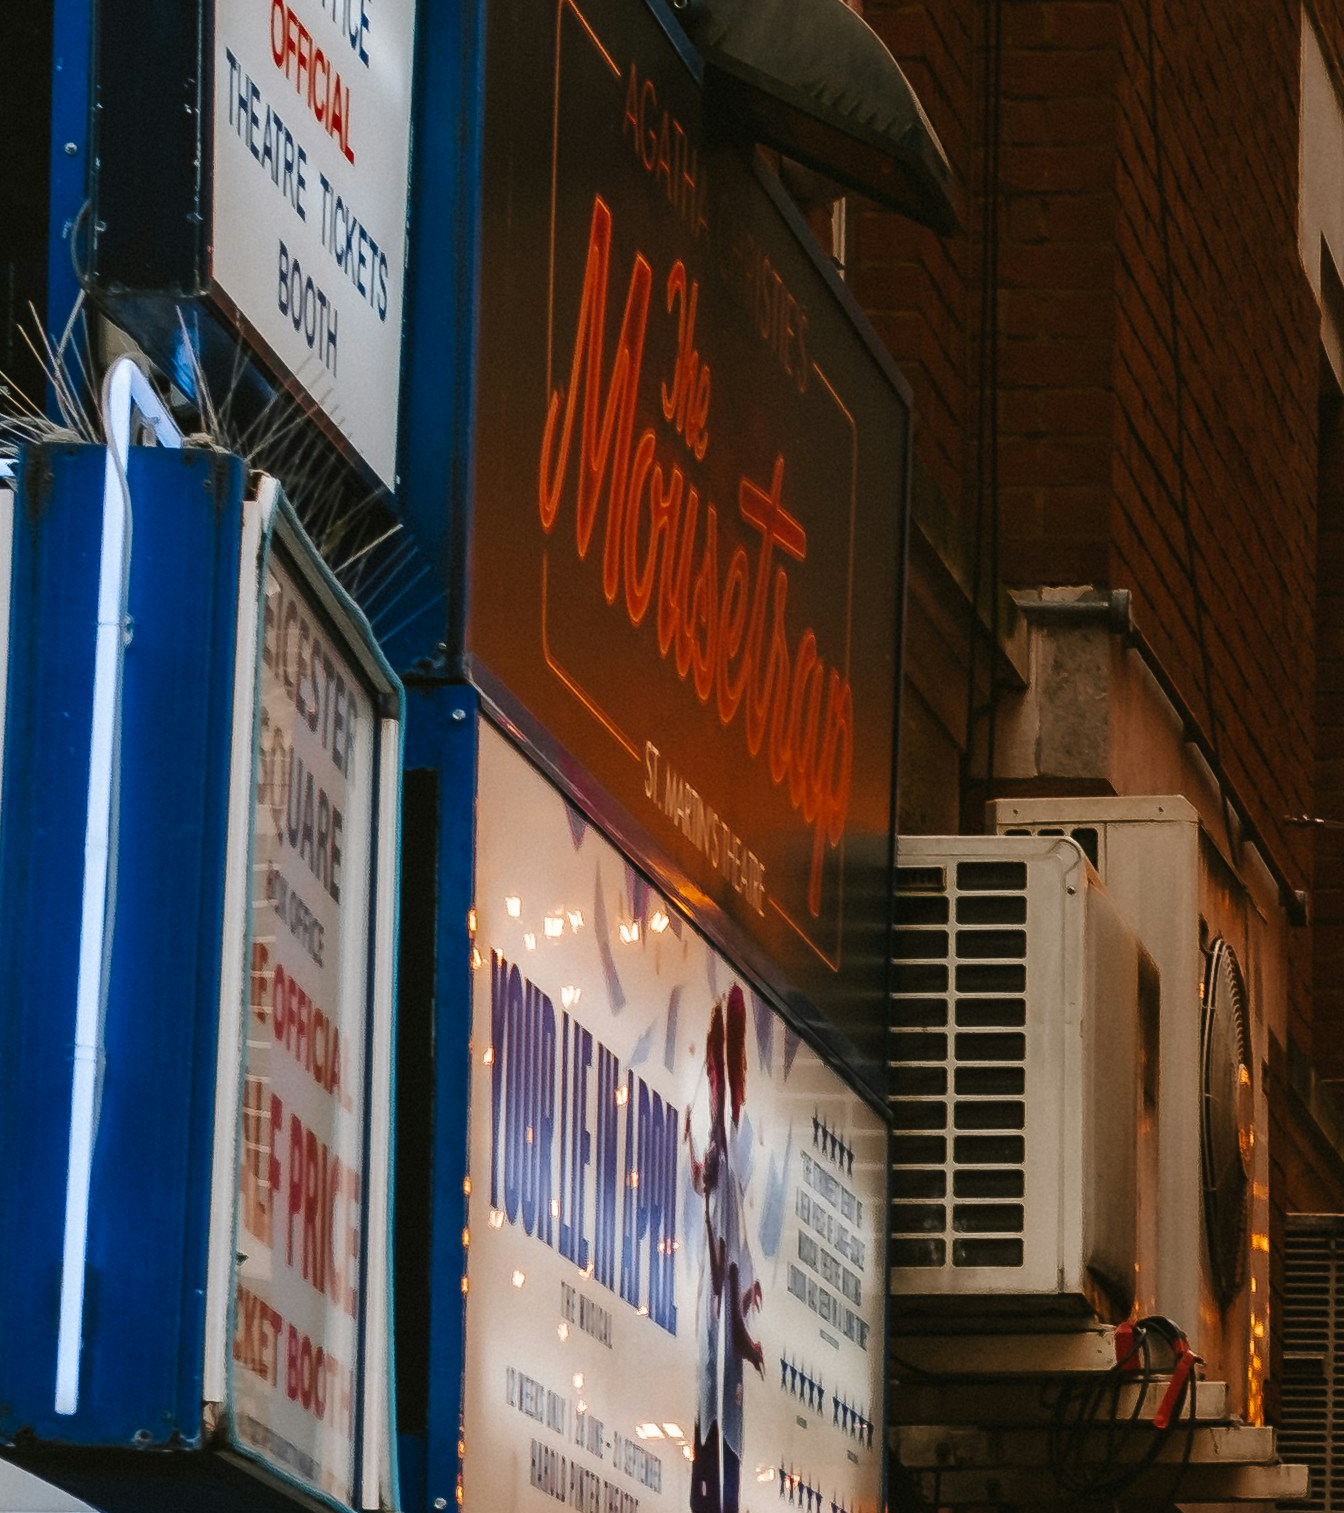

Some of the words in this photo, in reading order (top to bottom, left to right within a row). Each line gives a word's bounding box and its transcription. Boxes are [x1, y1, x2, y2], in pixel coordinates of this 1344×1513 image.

[226, 46, 307, 223] THEATRE
[319, 161, 389, 323] TICKETS
[276, 239, 339, 378] BOOTH
[660, 257, 714, 464] The
[540, 193, 854, 919] Mousetrap
[289, 890, 324, 967] OFFICE
[272, 962, 352, 1112] OFFICIAL
[285, 1113, 360, 1321] PRICE
[285, 1322, 353, 1440] BOOTH
